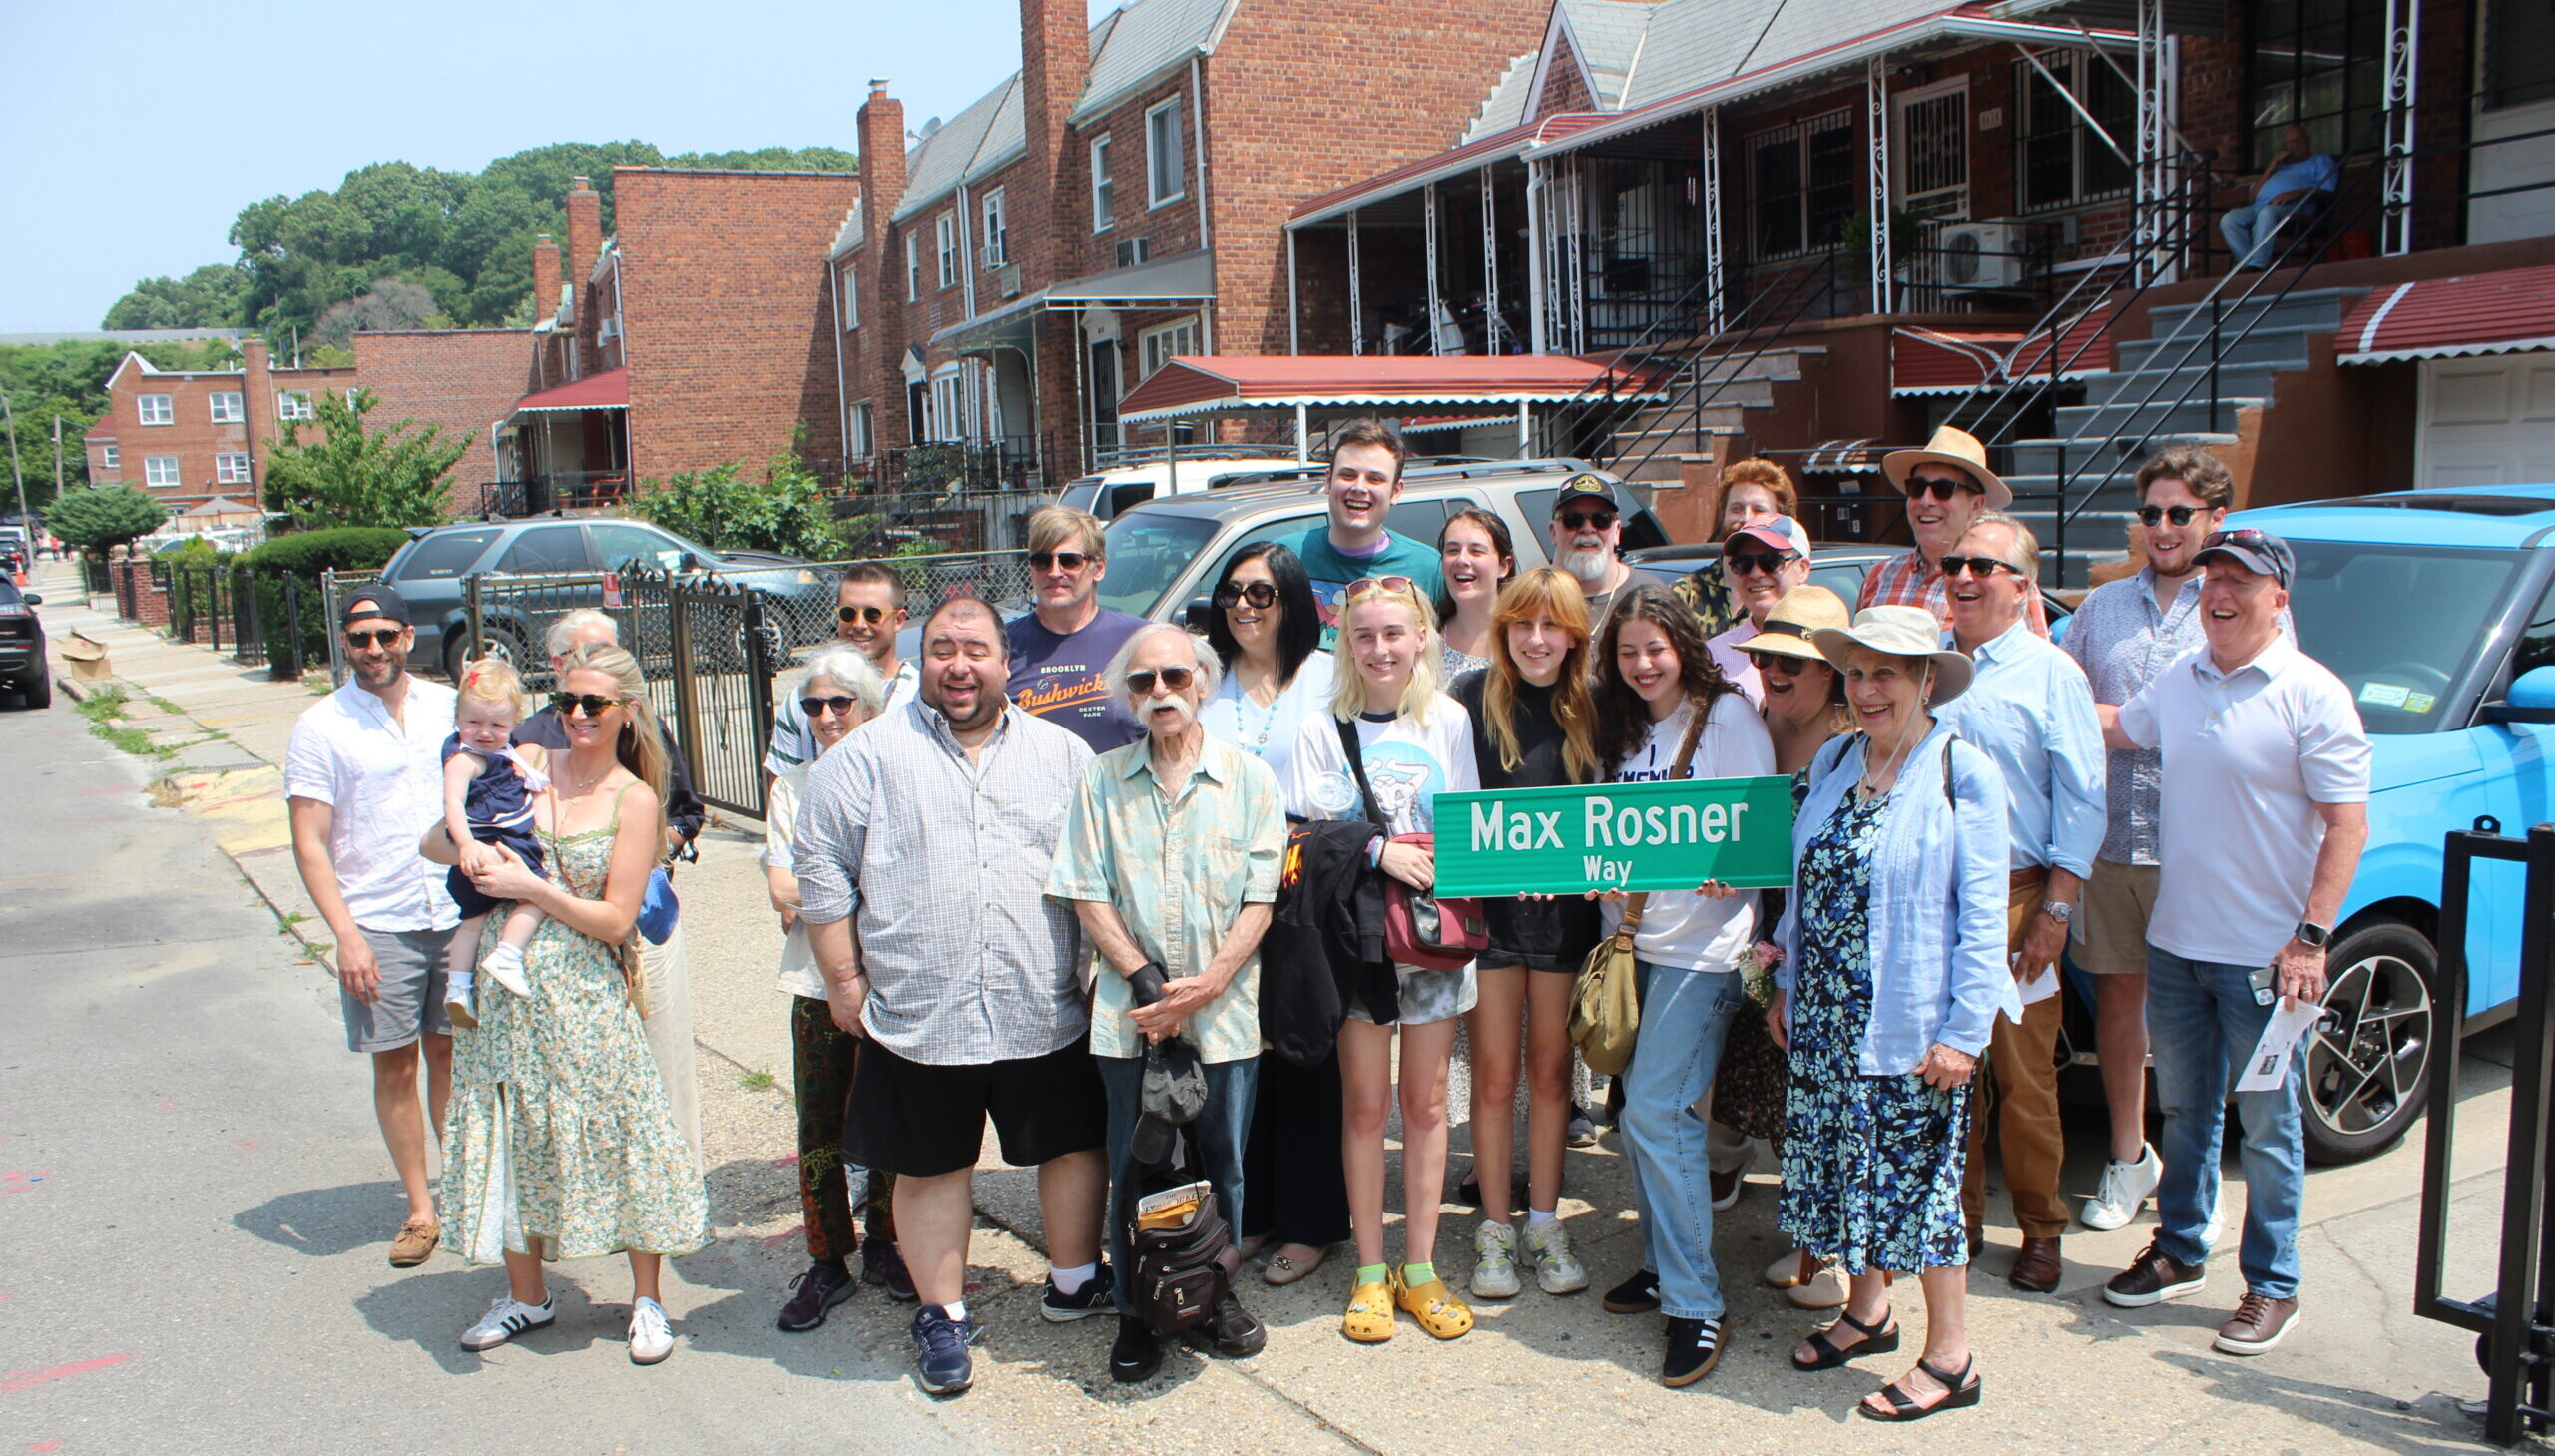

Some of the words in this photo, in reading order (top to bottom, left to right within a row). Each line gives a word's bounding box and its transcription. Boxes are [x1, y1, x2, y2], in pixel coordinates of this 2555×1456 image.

[1041, 664, 1086, 674] BROOKLYN
[1018, 672, 1112, 710] Bushwick
[1649, 744, 1656, 767] I
[1471, 800, 1565, 852] Max
[1584, 796, 1749, 848] Rosner
[1583, 854, 1633, 887] Way
